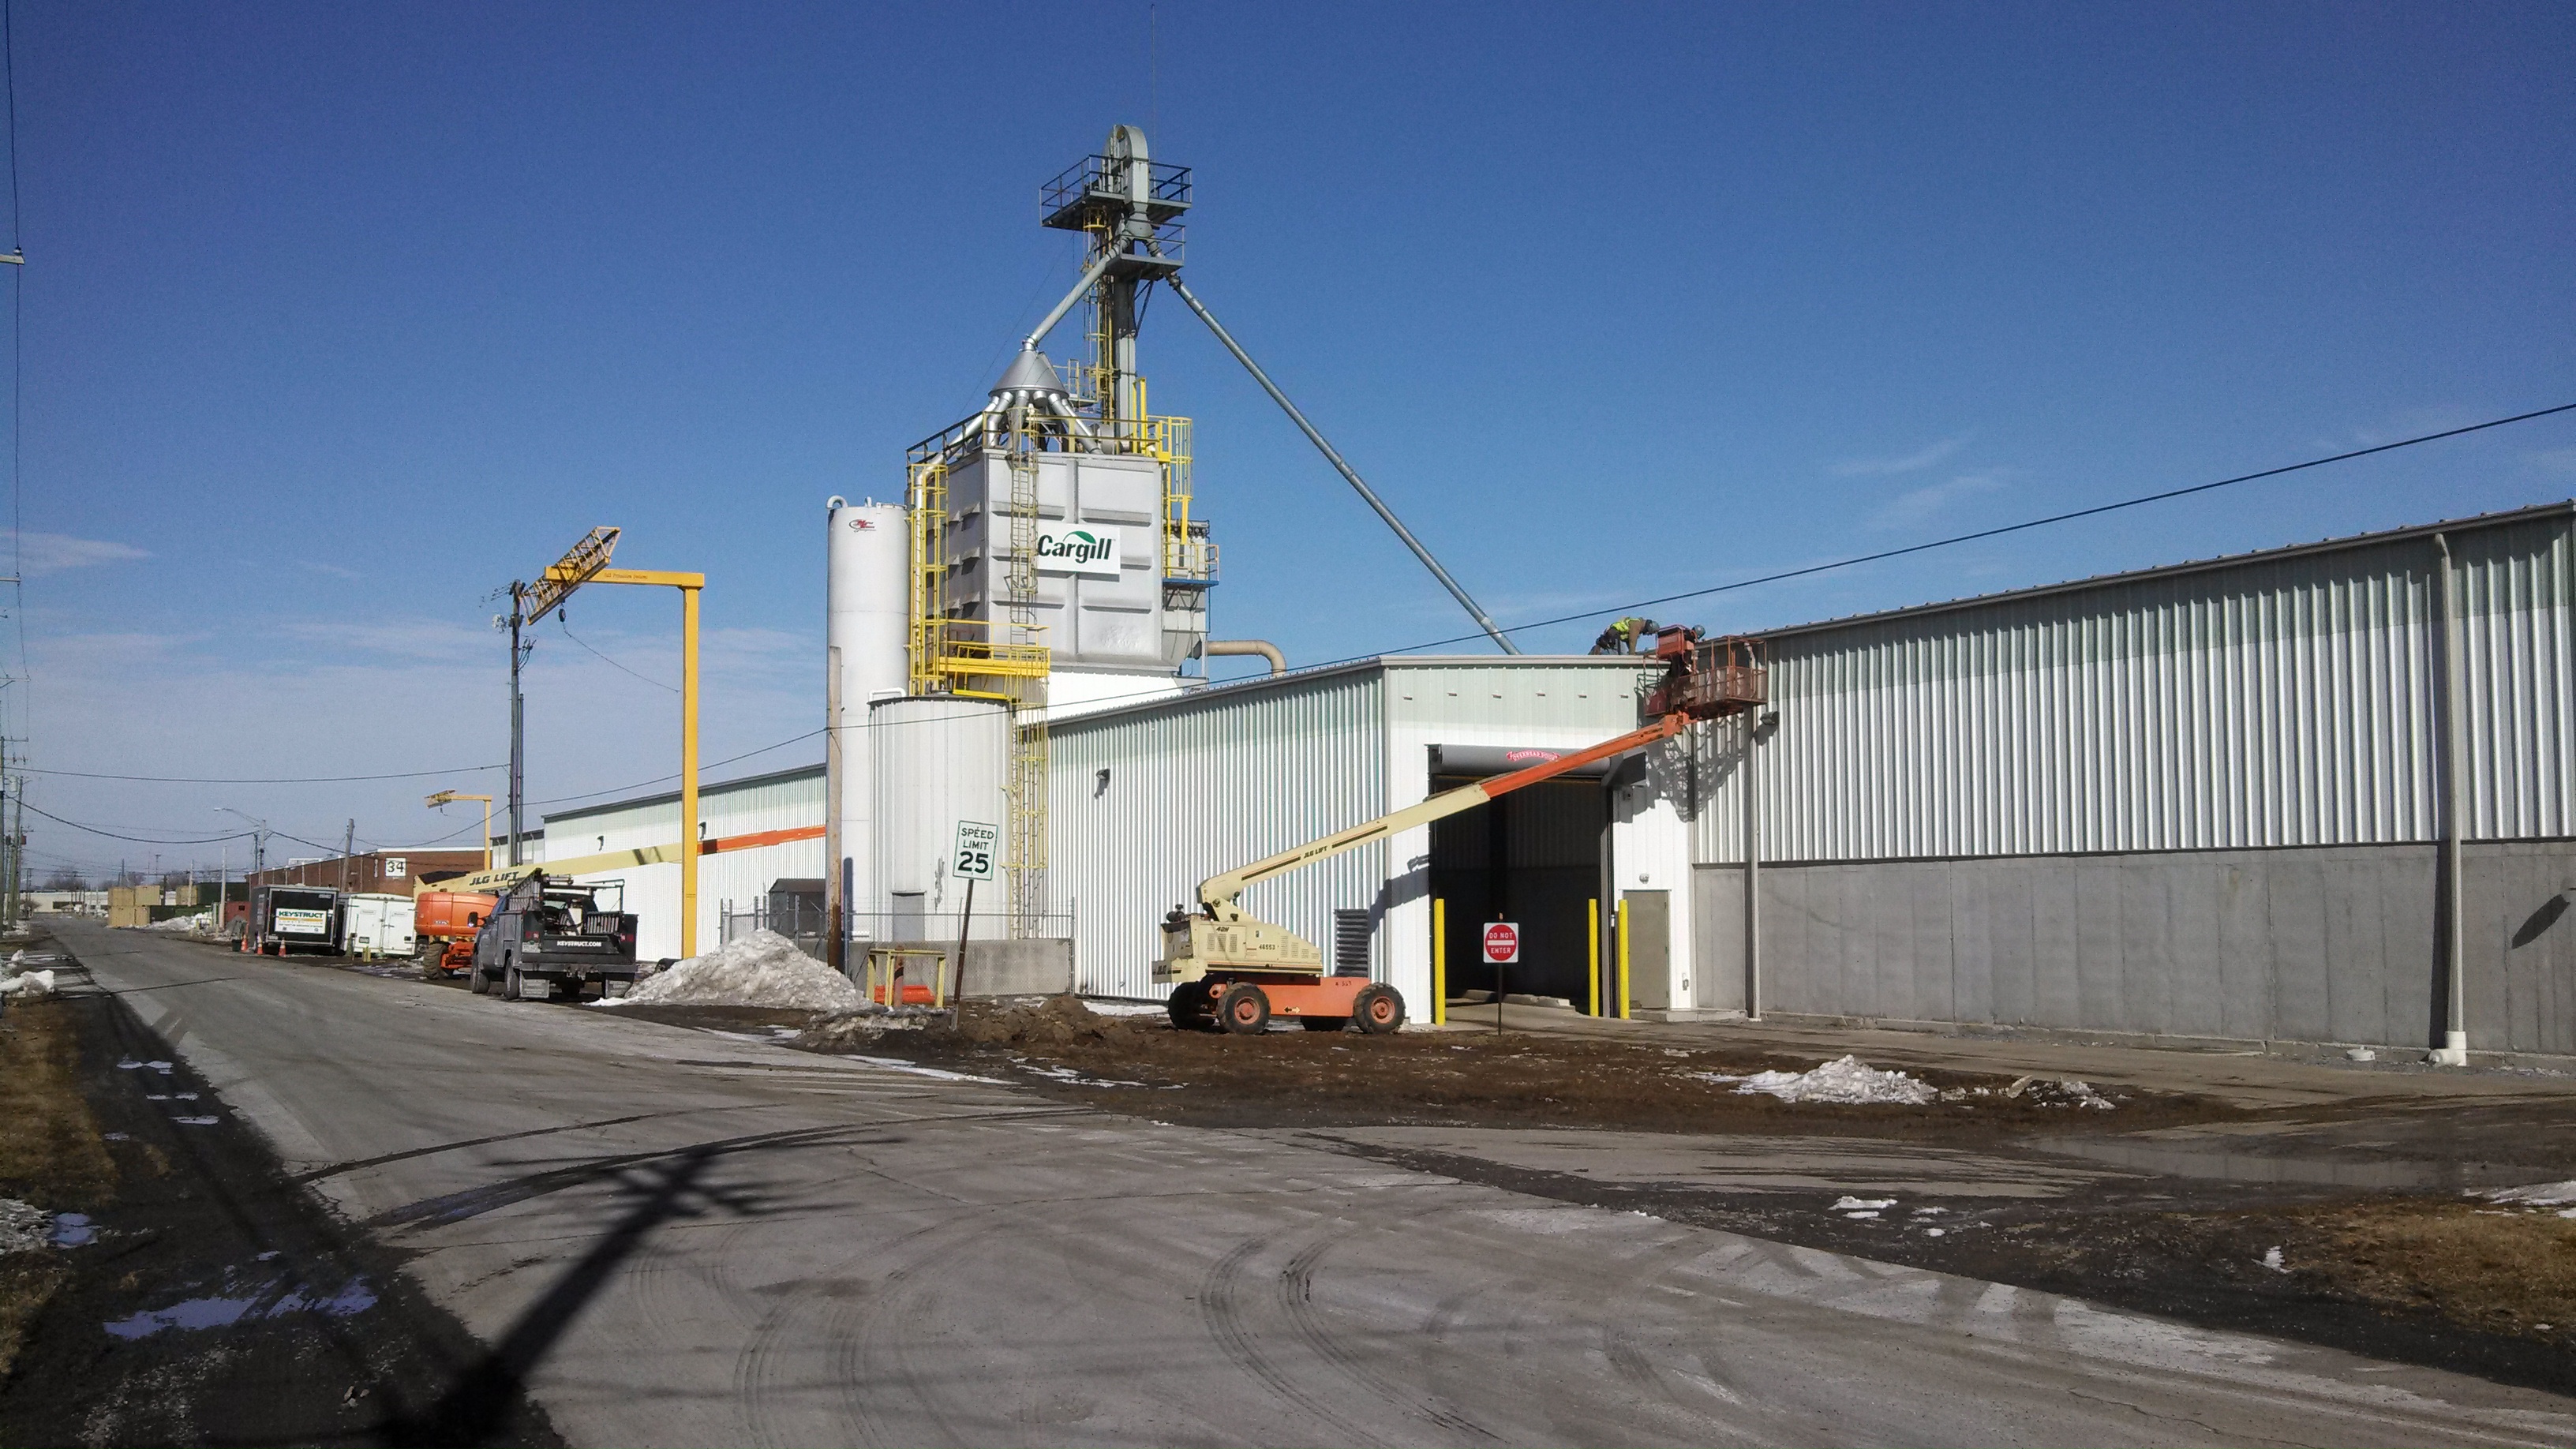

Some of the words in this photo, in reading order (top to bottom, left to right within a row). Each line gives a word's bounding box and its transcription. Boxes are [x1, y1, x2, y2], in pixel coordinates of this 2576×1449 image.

[1038, 534, 1112, 564] Cargill
[960, 826, 994, 840] SPEED
[963, 839, 989, 850] LIMIT
[1315, 845, 1327, 855] LIFT
[387, 860, 404, 873] 34
[957, 851, 989, 874] 25
[469, 875, 491, 886] JLG
[493, 871, 519, 882] LIFT
